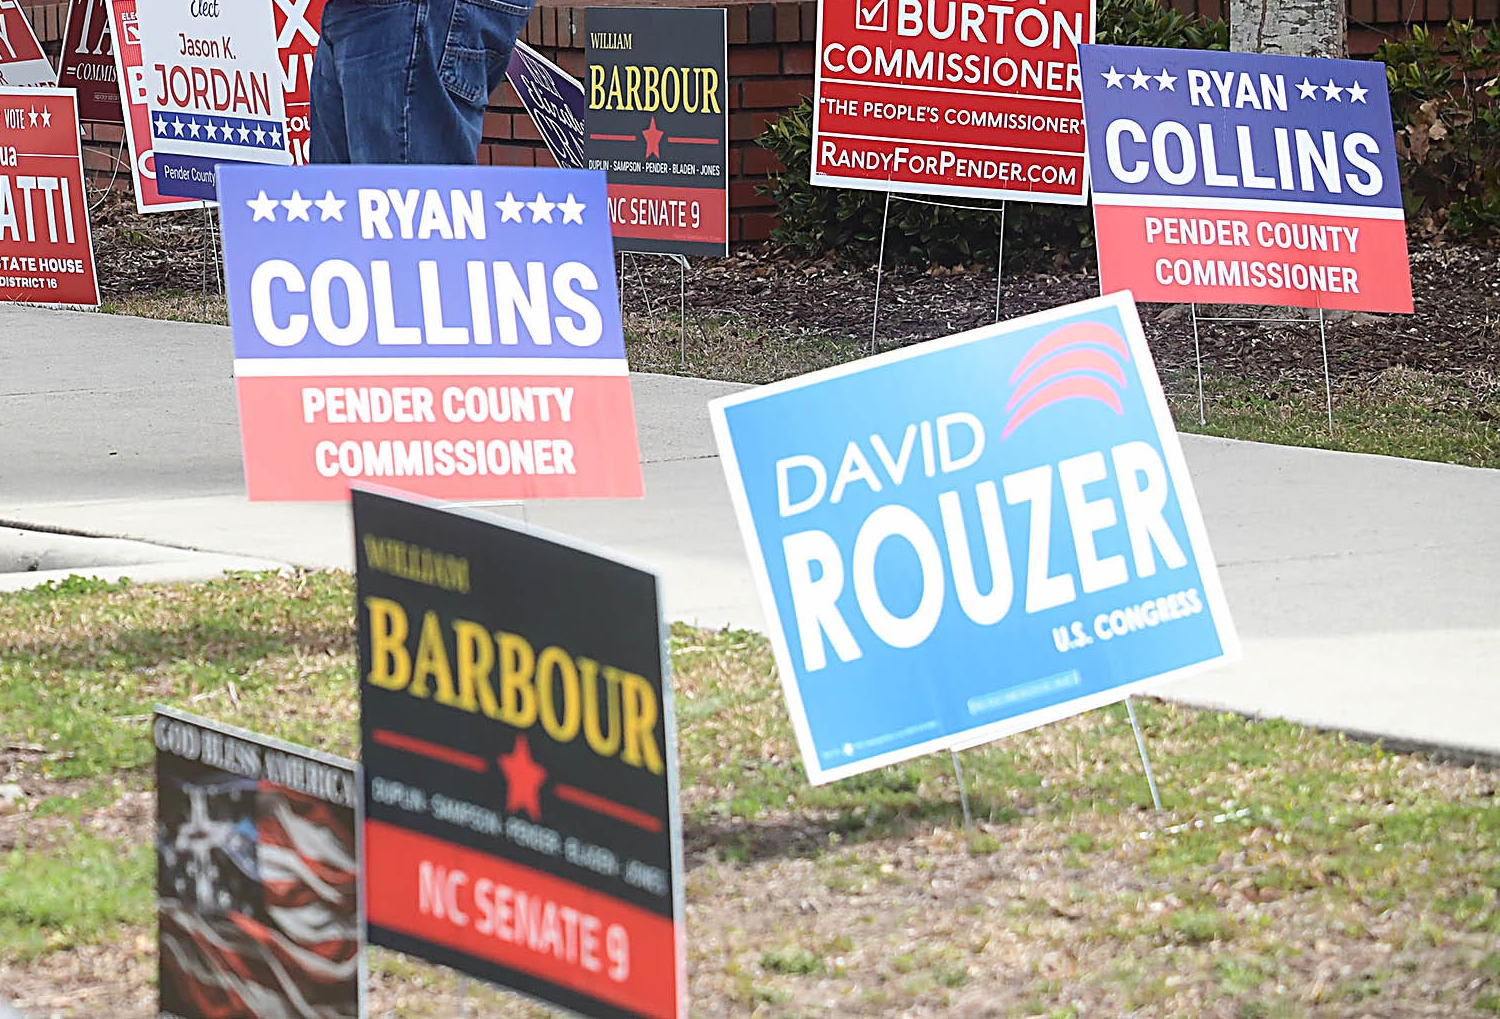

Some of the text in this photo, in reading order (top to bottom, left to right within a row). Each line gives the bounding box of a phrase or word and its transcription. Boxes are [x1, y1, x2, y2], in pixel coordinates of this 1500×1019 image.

[179, 33, 236, 59] Jason K.
[590, 32, 633, 50] WILLIAM
[76, 62, 117, 82] COMMIS
[823, 42, 1081, 92] COMMISSIONER
[154, 64, 271, 115] JORDAN
[589, 65, 721, 114] BARBOUR
[1187, 69, 1288, 111] RYAN
[3, 108, 25, 130] VOTE
[863, 102, 939, 123] PEOPLE'S
[164, 165, 216, 186] Pender County
[588, 159, 720, 176] DUPLIN SAMPSON PENDER BLADEN JONES
[1105, 118, 1383, 197] COLLINS
[358, 188, 486, 240] RYAN
[607, 197, 700, 229] NC SENATE 9
[1145, 217, 1359, 253] PENDER COUNTY
[38, 258, 84, 273] HOUSE
[46, 277, 58, 290] 16
[1155, 258, 1359, 294] COMMISSIONER
[250, 259, 603, 347] COLLINS
[302, 387, 574, 423] PENDER COUNTY
[315, 439, 576, 478] COMMISSIONER
[776, 412, 985, 517] DAVID
[781, 440, 1188, 672] ROUZER
[1052, 588, 1203, 652] U.S. CONGRESS
[366, 595, 664, 775] BARBOUR
[155, 716, 357, 807] GOD BLESS AMERICA
[419, 860, 629, 982] NC SENATE 9
